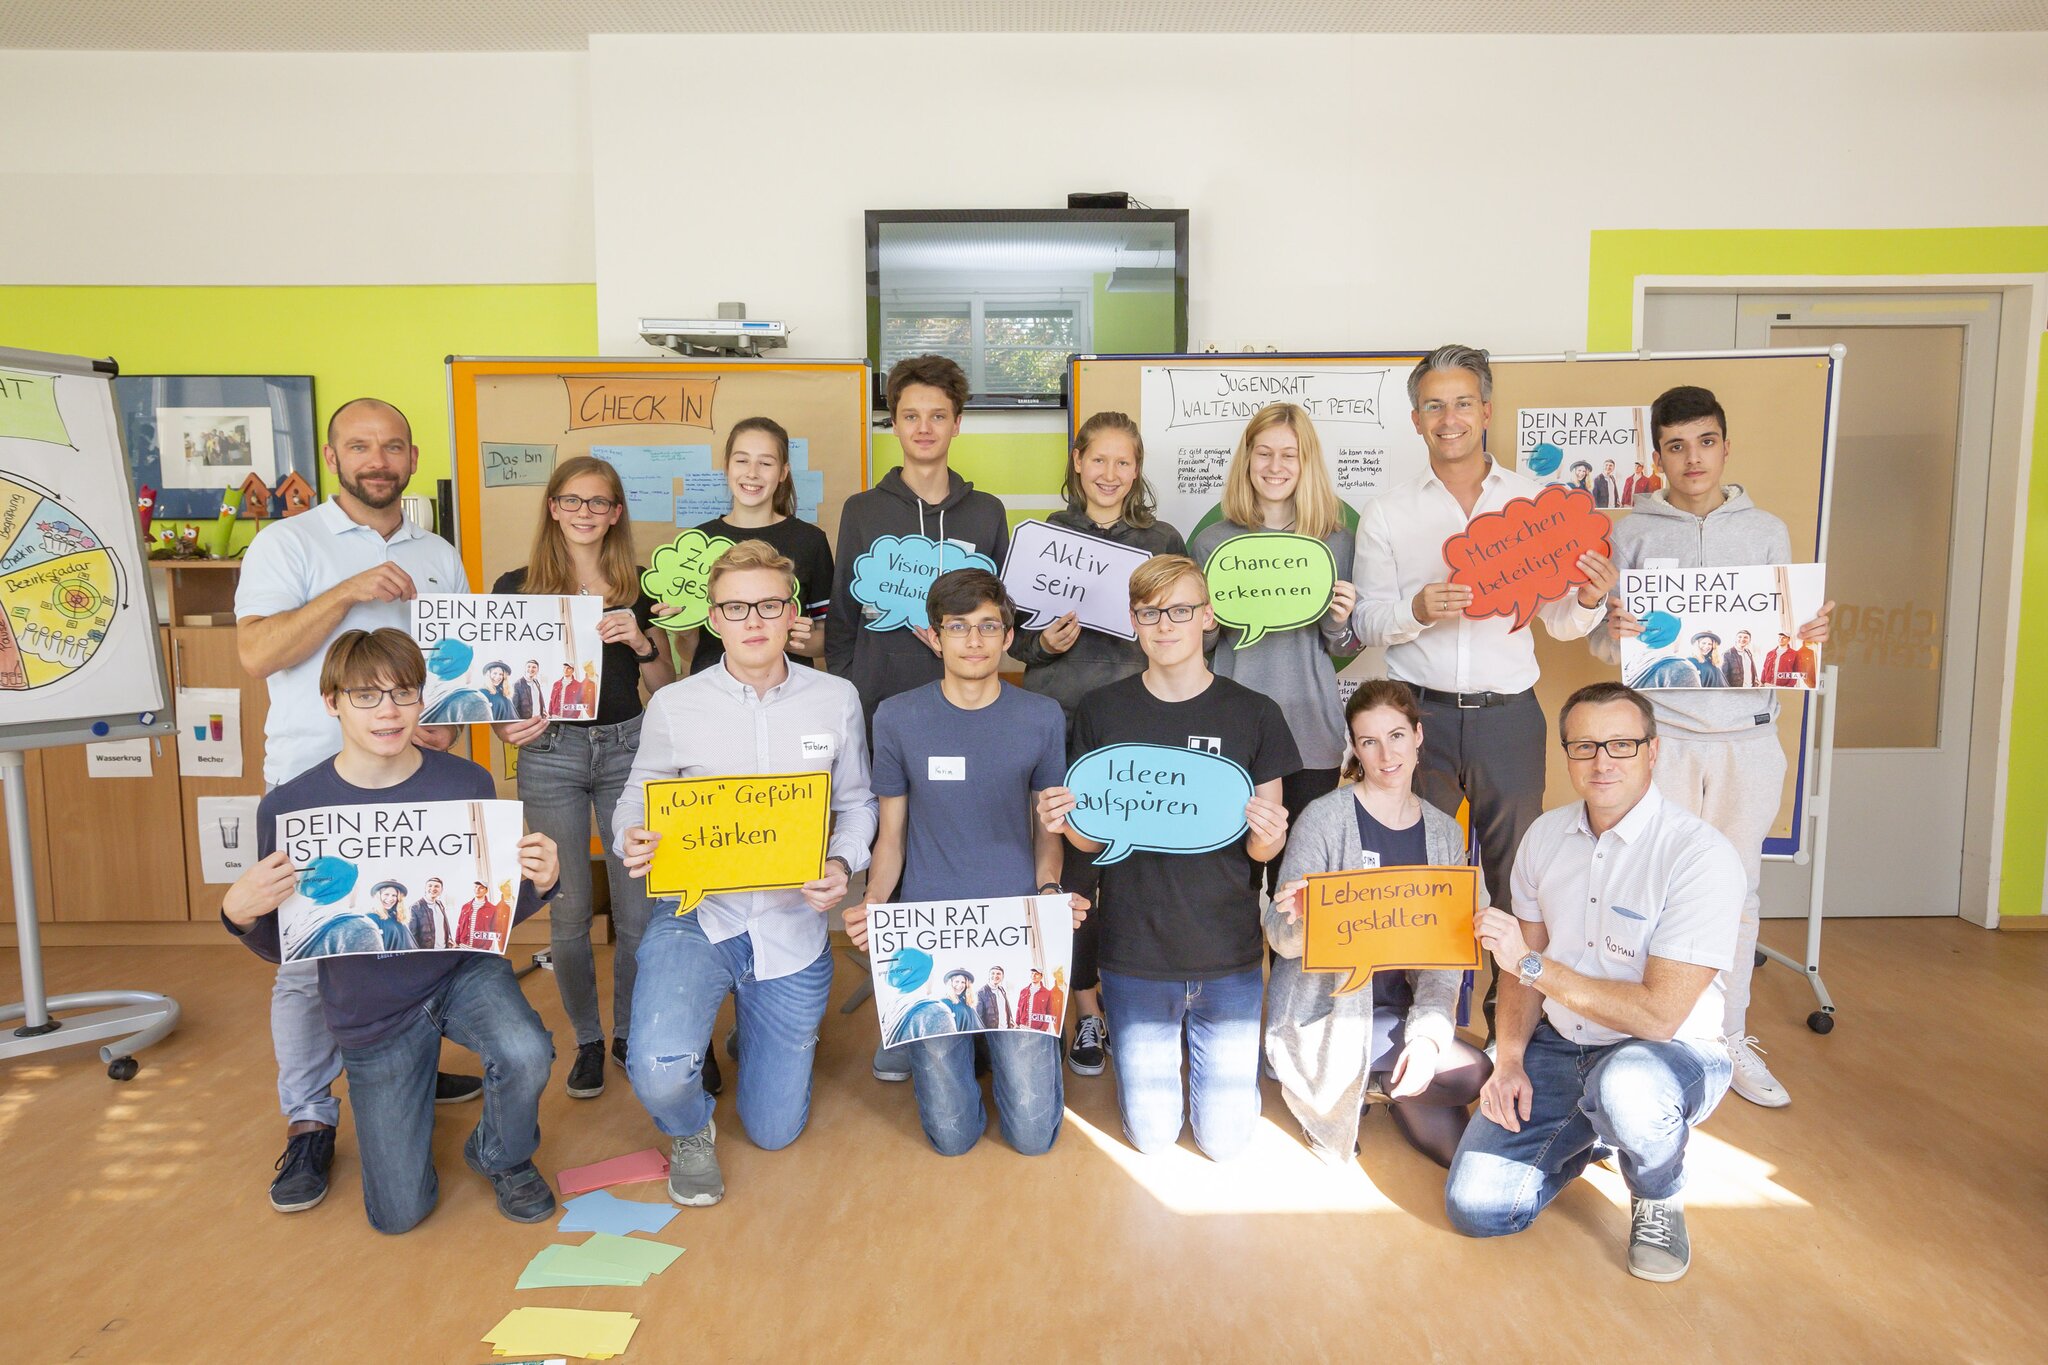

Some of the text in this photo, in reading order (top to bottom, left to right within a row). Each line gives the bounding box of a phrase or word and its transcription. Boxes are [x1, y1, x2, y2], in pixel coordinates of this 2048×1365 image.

[1217, 373, 1315, 396] JUGENDRAT
[580, 386, 703, 422] CHECK IN
[1327, 398, 1375, 416] PETER
[1522, 411, 1607, 428] DEIN RAT
[1522, 429, 1637, 446] IST GEFRAGT
[486, 449, 542, 469] Das bin
[1464, 510, 1567, 568] Menschen
[1039, 540, 1110, 576] Aktiv
[1219, 555, 1309, 572] Chancen
[1477, 538, 1580, 596] beteiligen
[1032, 573, 1087, 602] sein
[1214, 585, 1312, 602] erkennen
[1626, 572, 1739, 594] DEIN RAT
[418, 600, 528, 620] DEIN RAT
[1626, 592, 1782, 614] IST GEFRAGT
[418, 622, 566, 642] IST GEFRAGT
[96, 754, 142, 763] Wasserkrug
[1109, 759, 1186, 786] Ideen
[735, 783, 812, 807] Gefühl
[1075, 788, 1198, 821] aufspüren
[285, 809, 428, 838] DEIN RAT
[285, 833, 477, 862] IST GEFRAGT
[682, 822, 777, 850] stärken
[1321, 881, 1452, 906] Lebensraum
[874, 905, 990, 929] DEIN RAT
[1337, 909, 1438, 945] gestalten
[875, 925, 1032, 954] IST GEFRAGT
